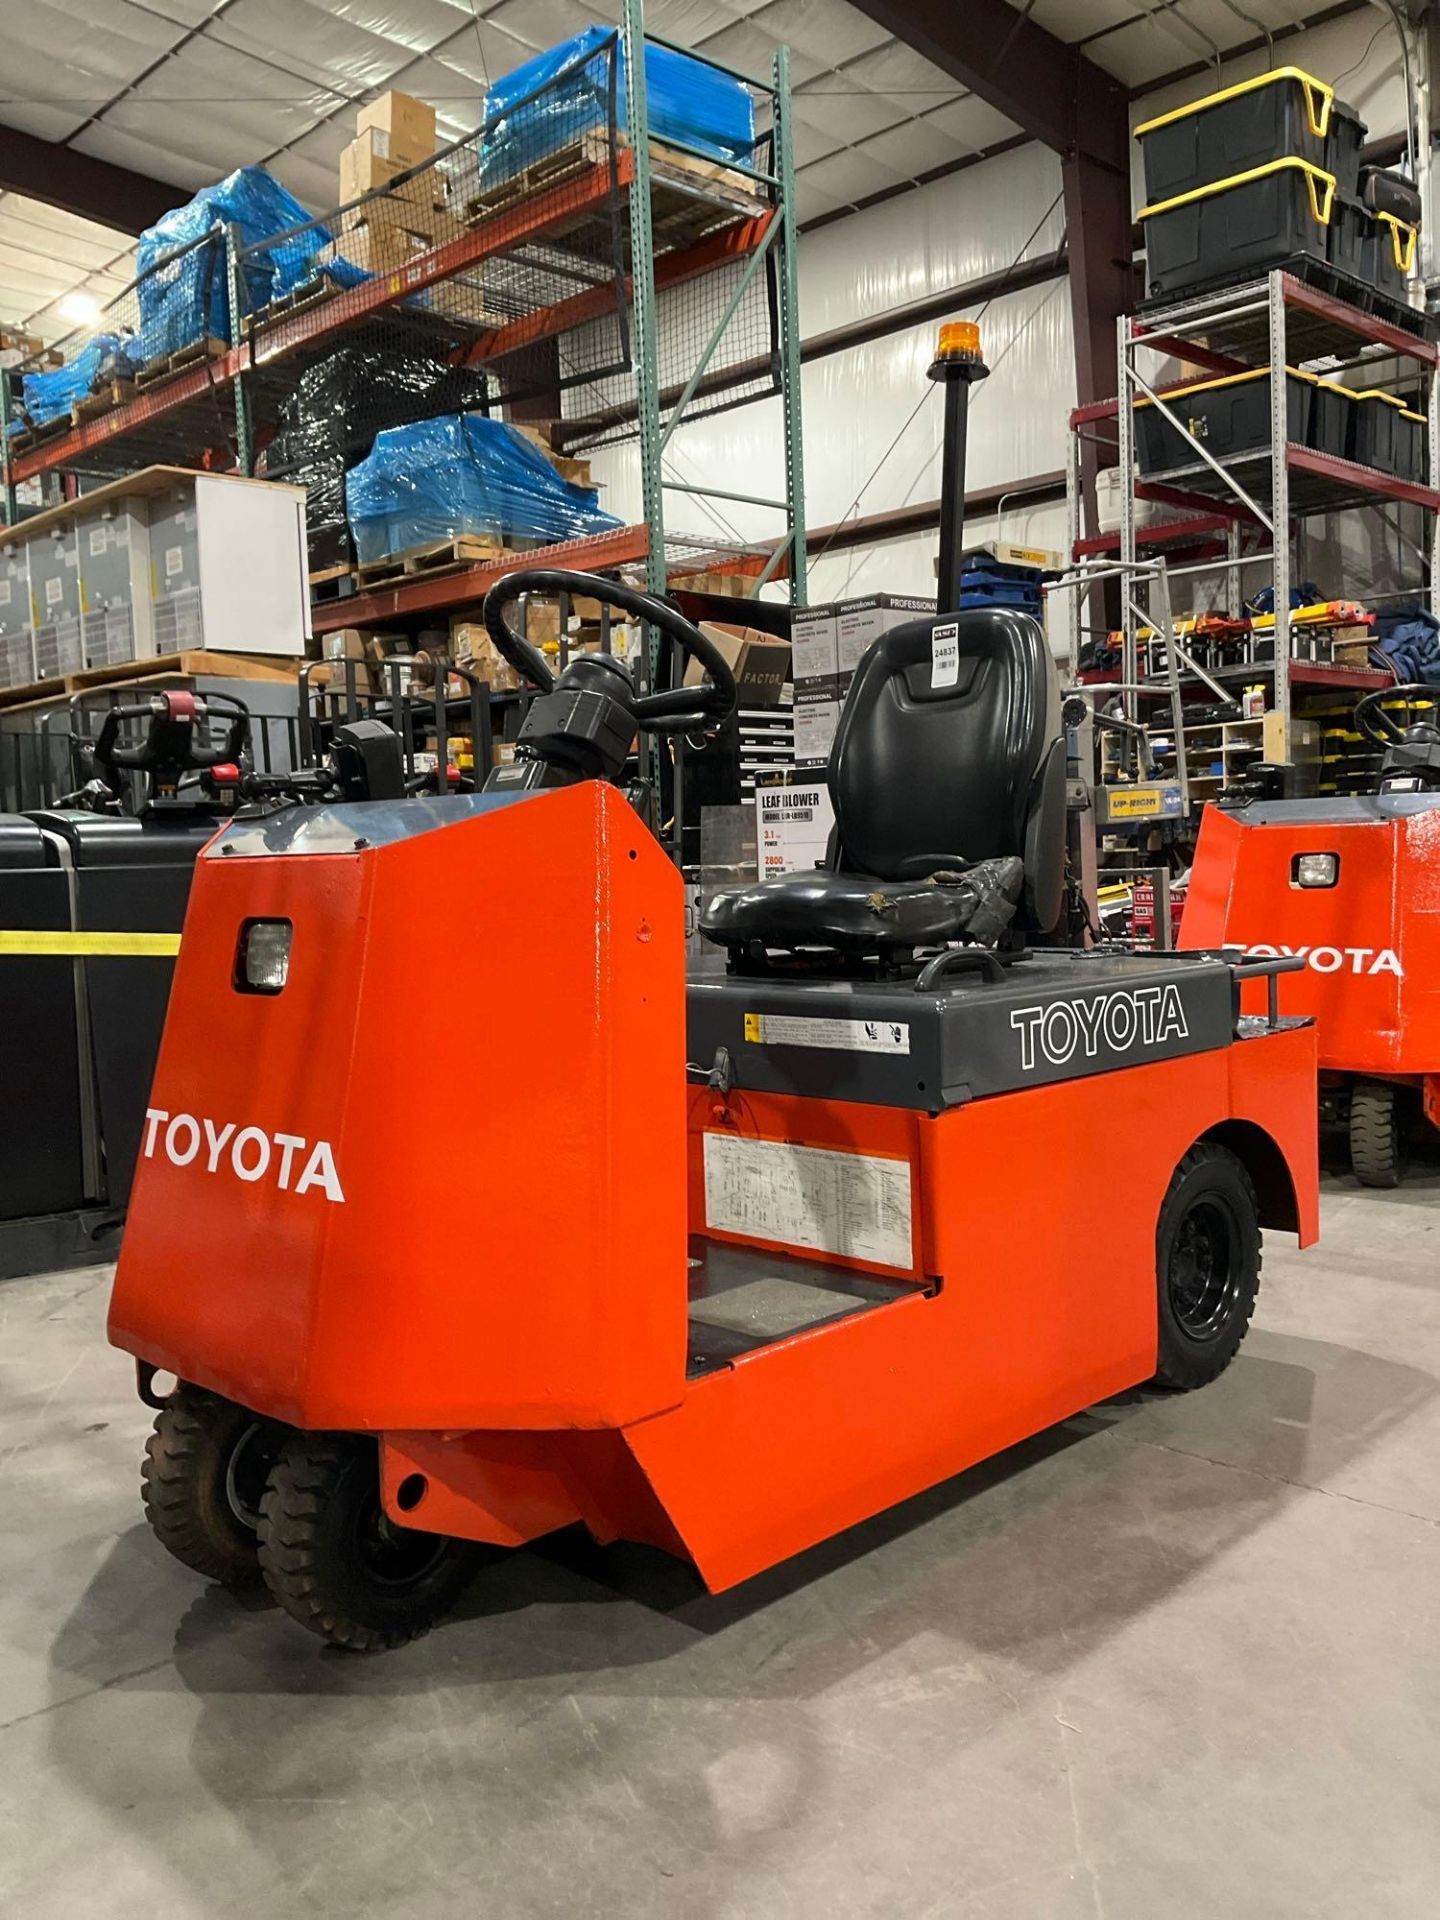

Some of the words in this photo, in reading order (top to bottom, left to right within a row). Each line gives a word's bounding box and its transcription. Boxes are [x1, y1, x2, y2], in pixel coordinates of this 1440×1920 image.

[840, 600, 878, 612] PROFESSIONAL
[890, 598, 937, 611] PROFESSIONA
[795, 610, 830, 620] PROFESSIONAL
[934, 646, 956, 658] 24837
[797, 693, 833, 702] PROFESSIONAL
[761, 795, 781, 808] LEAF
[782, 792, 820, 807] BLOWER
[764, 830, 775, 839] 3.1
[764, 855, 784, 865] 2800
[1010, 984, 1189, 1070] TOYOTA
[144, 1108, 346, 1203] TOYOTA
